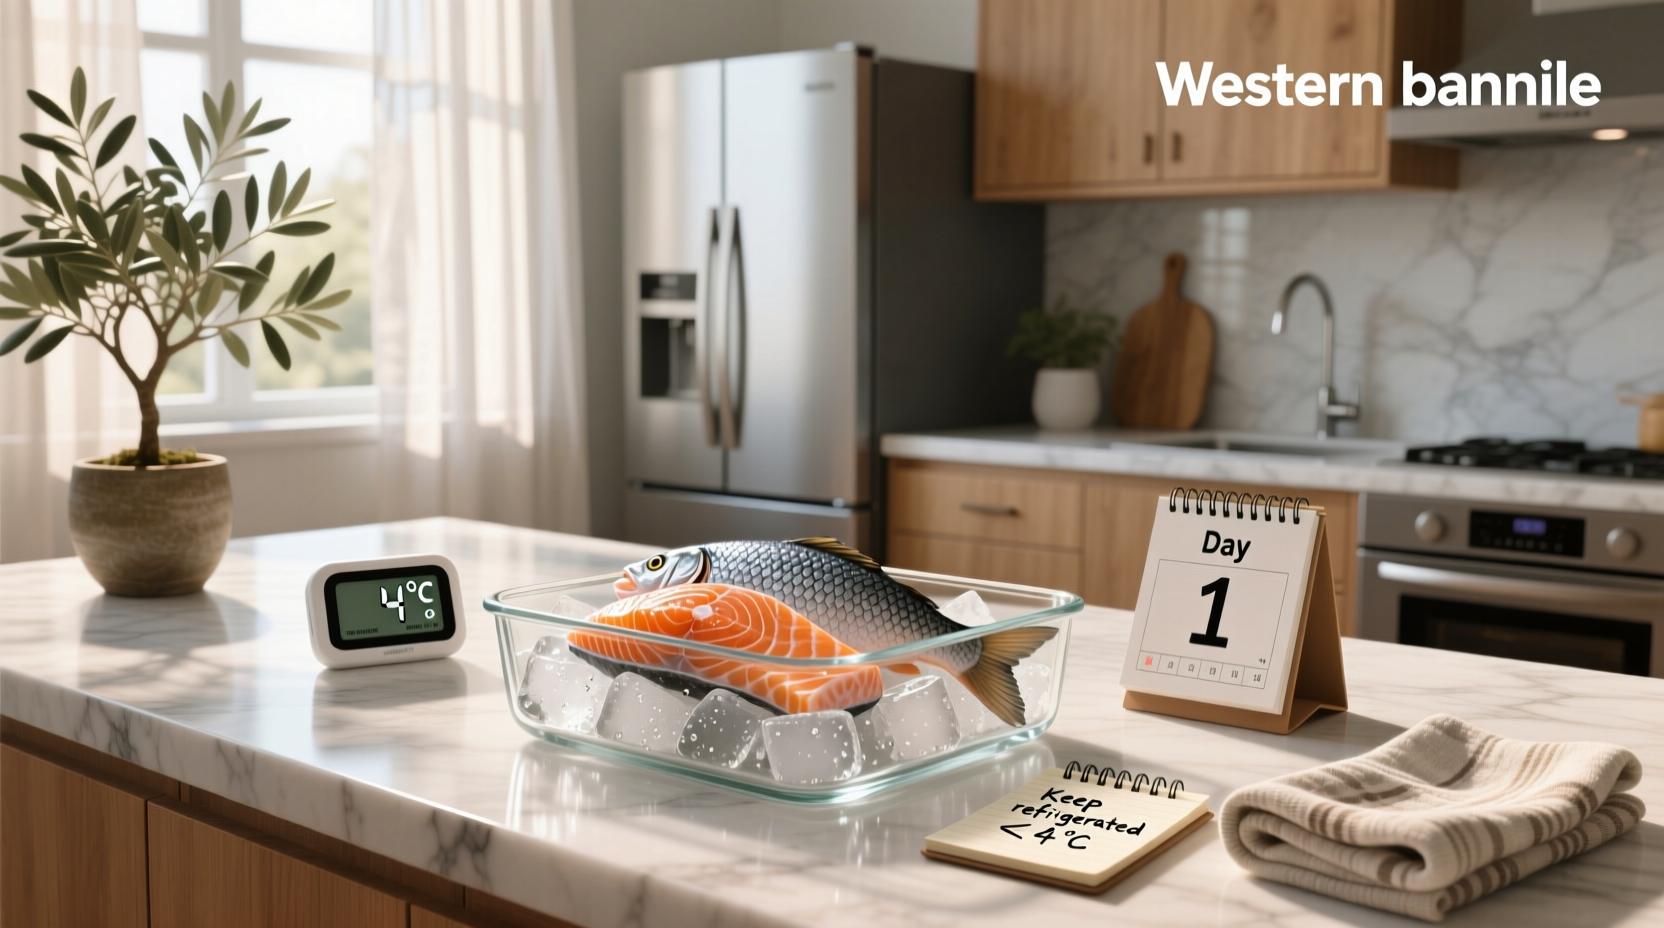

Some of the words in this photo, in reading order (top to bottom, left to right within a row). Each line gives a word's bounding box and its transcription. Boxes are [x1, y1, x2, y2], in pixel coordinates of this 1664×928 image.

[1201, 530, 1252, 564] Day
[380, 580, 434, 623] 4°C
[1189, 577, 1230, 649] 1
[1040, 787, 1103, 813] Keep
